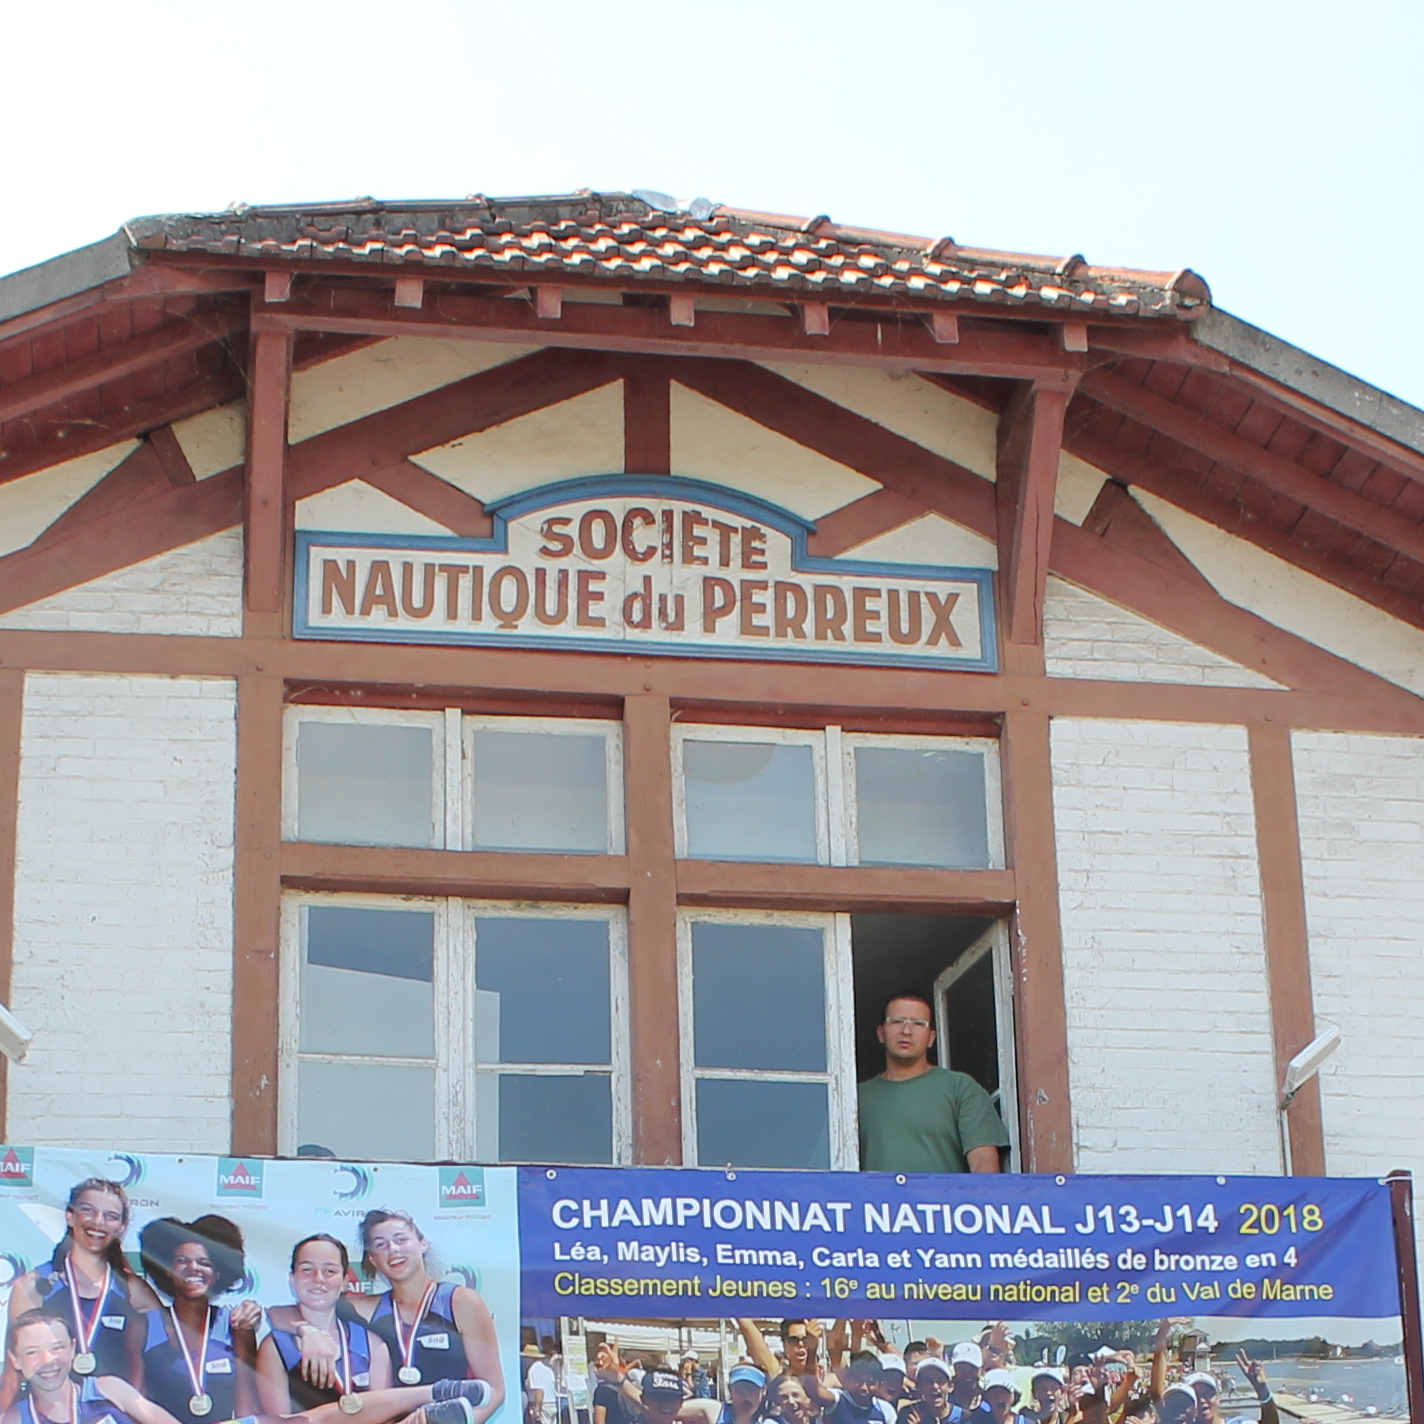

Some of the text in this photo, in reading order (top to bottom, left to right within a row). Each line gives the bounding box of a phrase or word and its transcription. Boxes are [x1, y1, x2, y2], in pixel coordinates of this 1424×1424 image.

[320, 558, 962, 648] NAUTIQUE du PERREUX
[219, 1174, 261, 1185] MAIF
[441, 1184, 482, 1195] MAIF
[552, 1197, 1324, 1234] CHAMPIONNAT NATIONAL J13-J14 2018
[554, 1241, 1298, 1271] Léa, Maylis, Emma, Carla et Yann médaillés de bronze en 4
[347, 1281, 372, 1293] AIF
[554, 1272, 702, 1297] Classement
[708, 1275, 797, 1299] Jeunes
[866, 1283, 895, 1300] au
[904, 1278, 981, 1301] niveau
[990, 1281, 1080, 1302] national
[1087, 1283, 1110, 1303] et
[1146, 1283, 1176, 1303] du
[1182, 1281, 1221, 1300] Val
[1227, 1278, 1256, 1299] de
[1262, 1278, 1334, 1301] Marne
